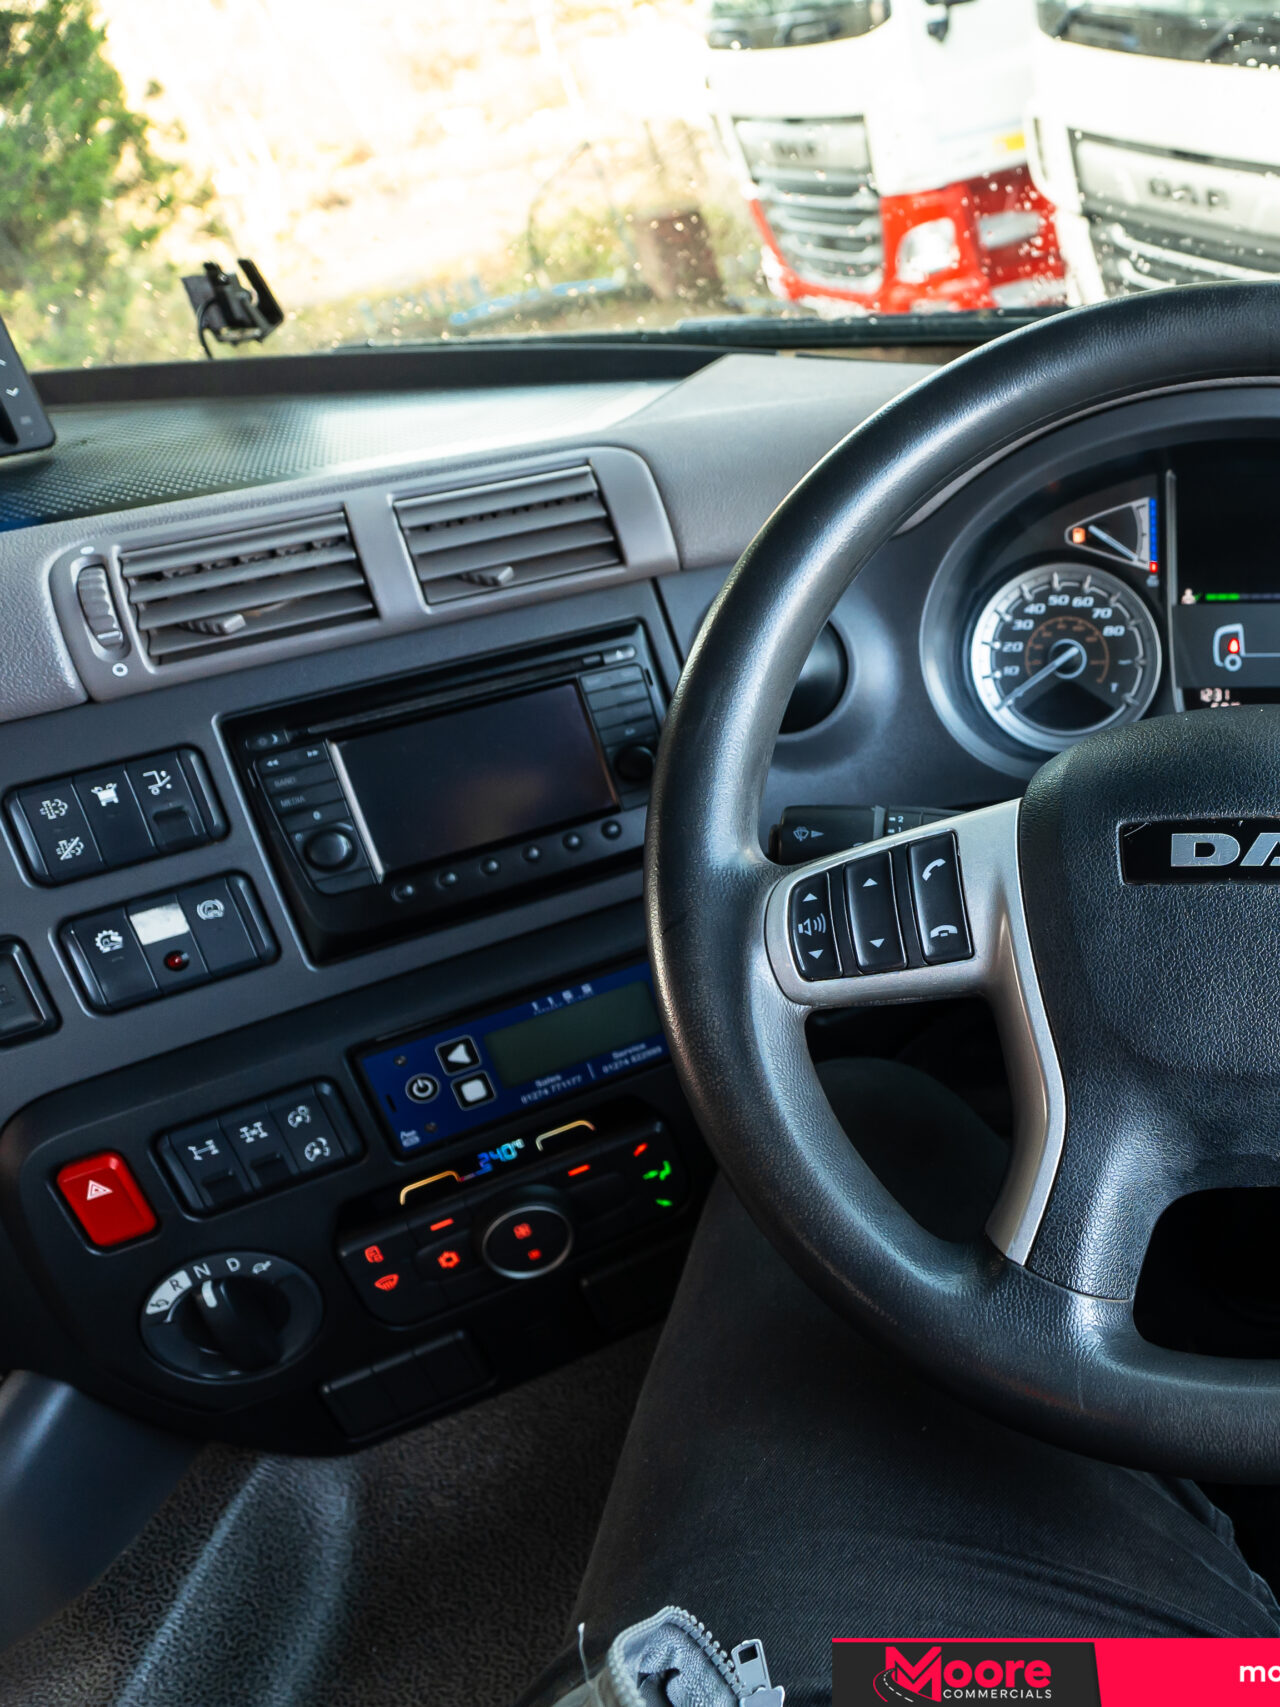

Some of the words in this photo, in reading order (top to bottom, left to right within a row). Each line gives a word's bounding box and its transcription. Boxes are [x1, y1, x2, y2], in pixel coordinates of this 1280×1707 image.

[1048, 594, 1070, 607] 50
[1072, 596, 1094, 608] 60
[1024, 603, 1046, 615] 40
[1091, 607, 1113, 620] 70
[1012, 619, 1034, 631] 30
[1103, 625, 1125, 637] 80
[1002, 641, 1024, 653] 20
[1003, 665, 1020, 677] 10
[897, 815, 904, 824] 2
[193, 1262, 211, 1279] N
[226, 1257, 240, 1272] D
[170, 1279, 183, 1291] R
